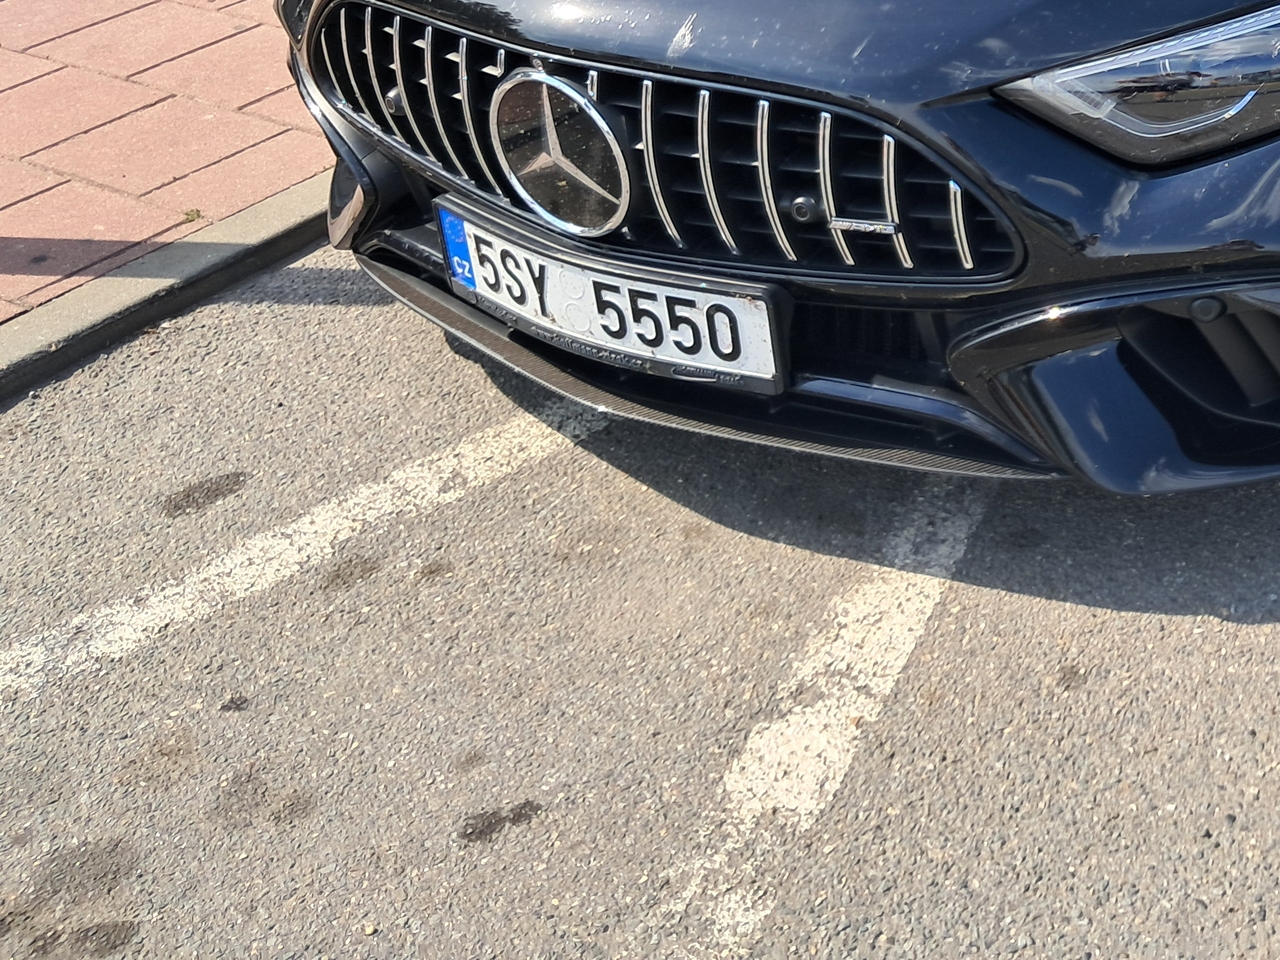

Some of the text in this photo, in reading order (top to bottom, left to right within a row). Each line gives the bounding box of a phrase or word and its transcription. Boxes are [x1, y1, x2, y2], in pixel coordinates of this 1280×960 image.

[453, 255, 472, 278] CZ
[472, 235, 742, 362] 5SY 5550
